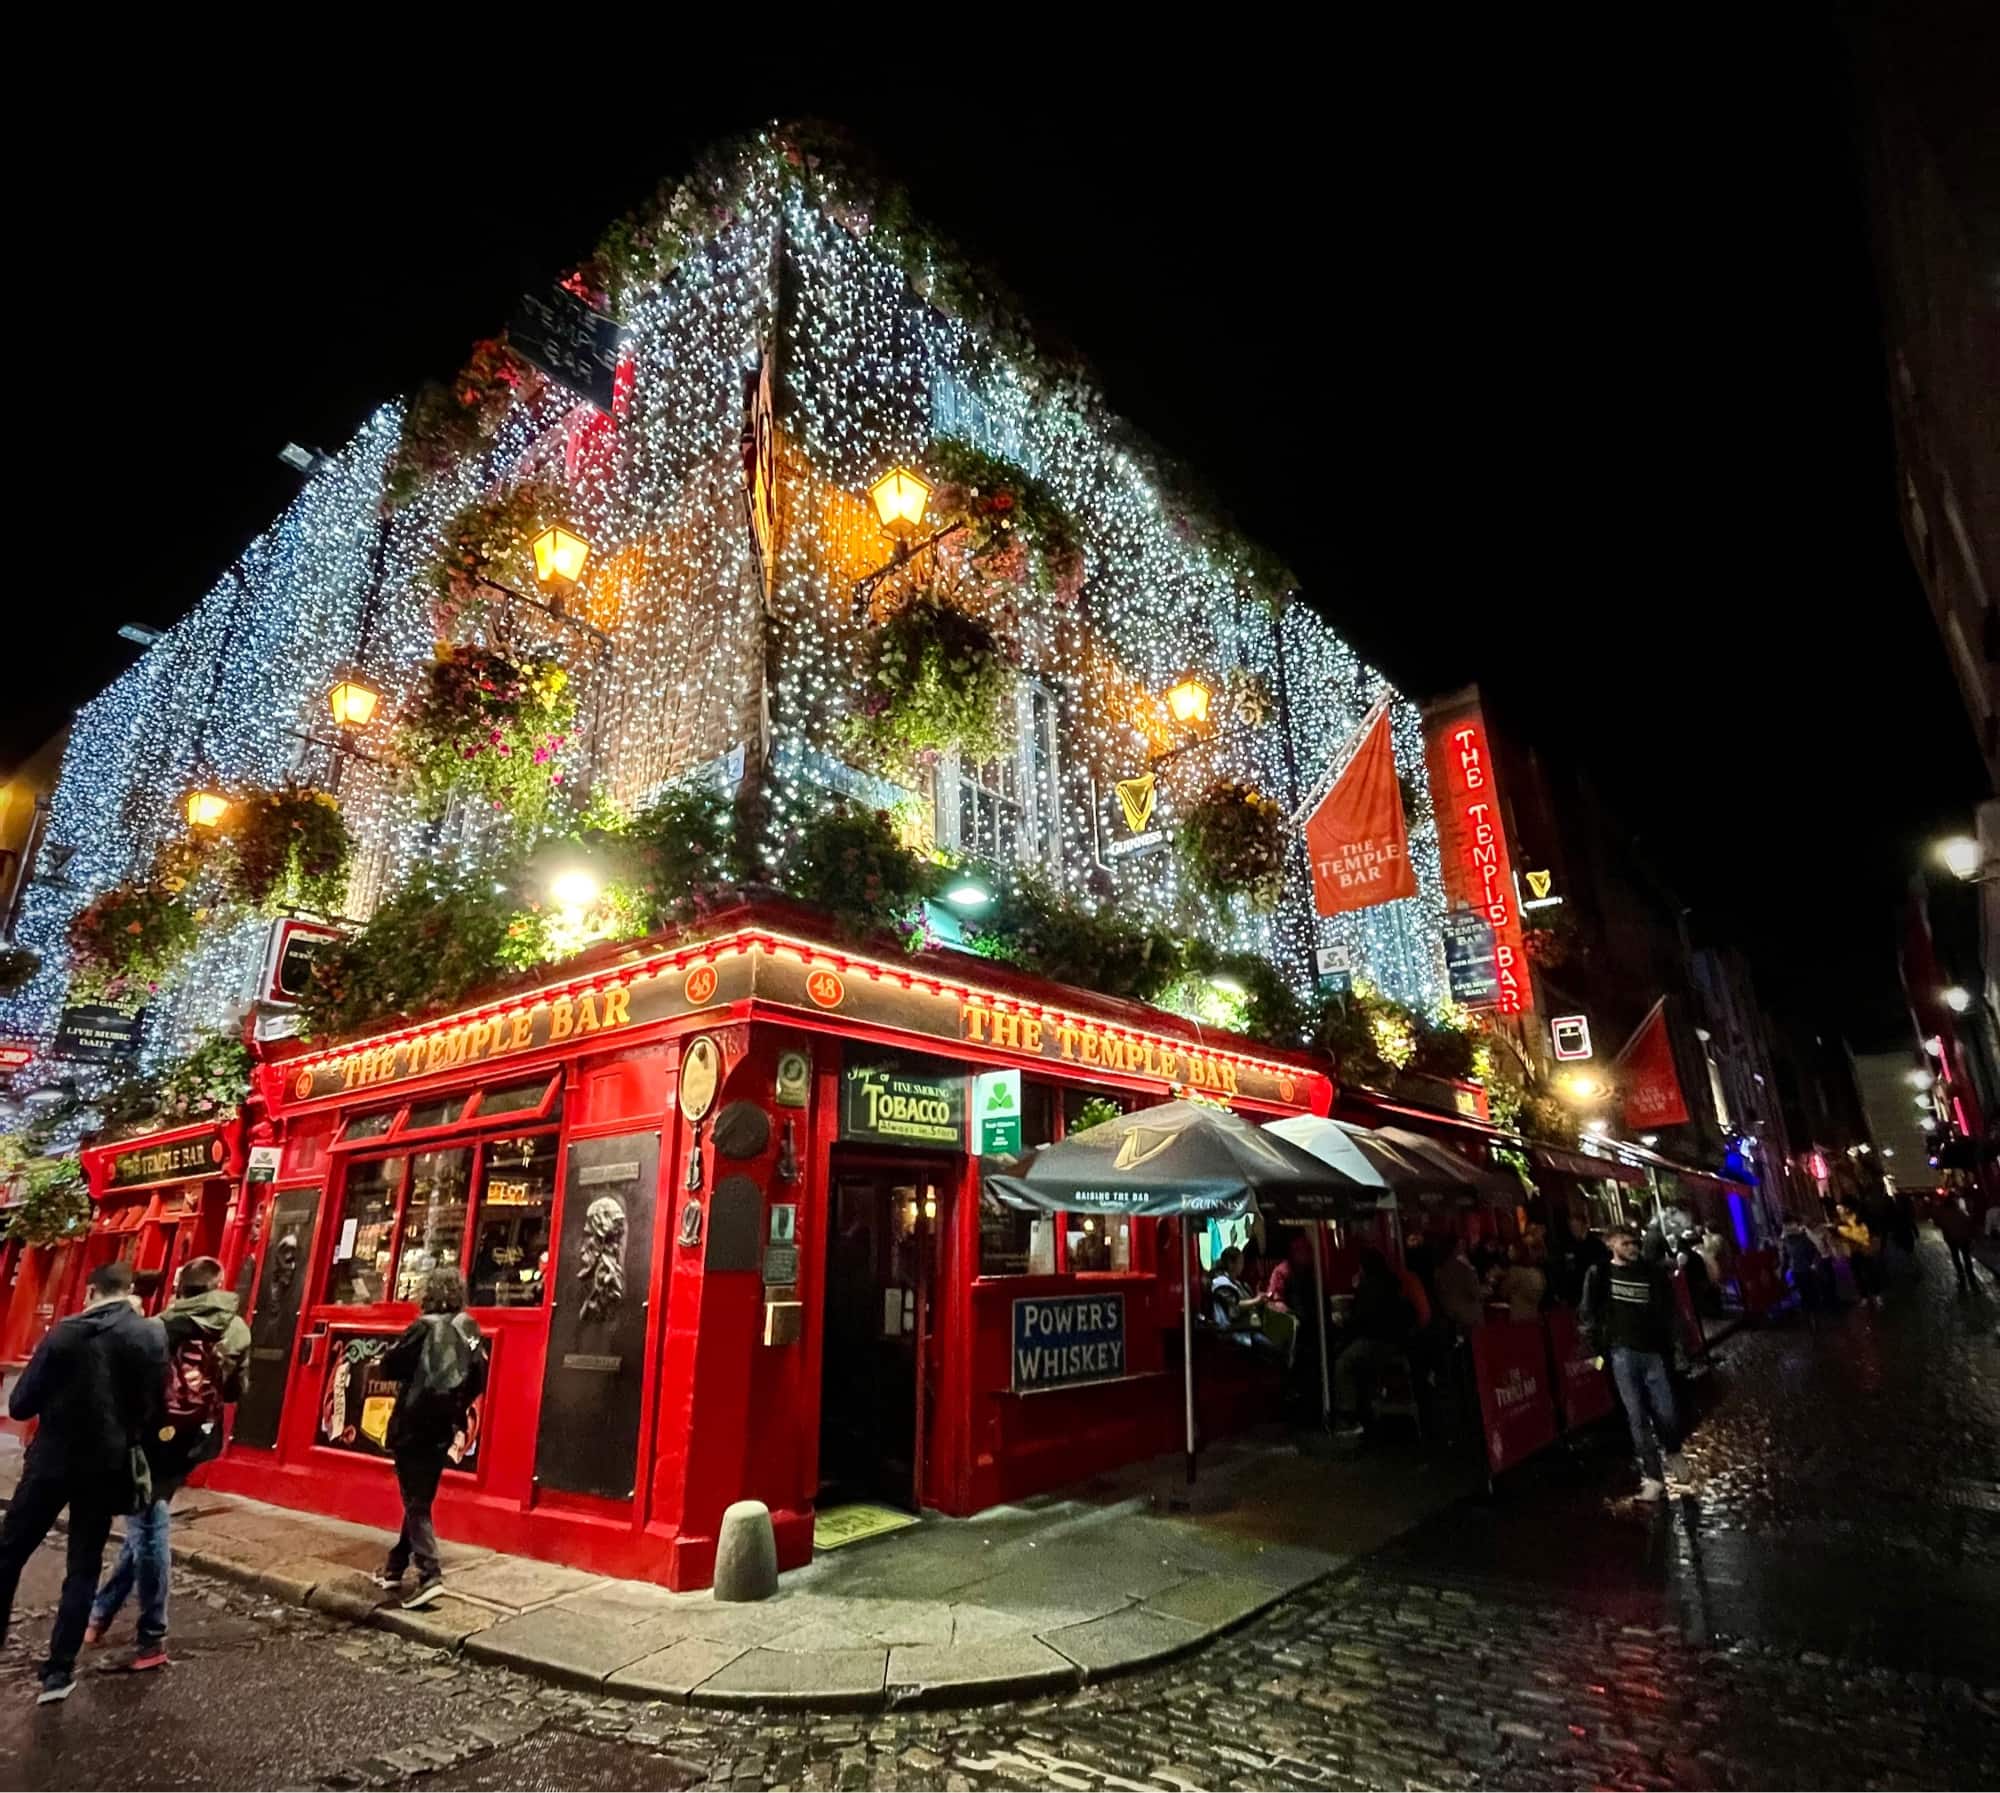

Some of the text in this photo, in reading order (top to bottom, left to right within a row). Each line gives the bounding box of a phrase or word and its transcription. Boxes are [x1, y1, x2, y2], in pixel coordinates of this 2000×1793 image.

[1455, 729, 1485, 789] THE
[1110, 830, 1163, 855] GUINNESS
[1340, 840, 1374, 857] THE
[1317, 844, 1401, 878] TEMPLE
[1468, 804, 1508, 927] TEMPLE
[1339, 866, 1382, 888] BAR
[690, 973, 712, 997] 48
[813, 976, 836, 999] 48
[1496, 946, 1521, 1013] BAR
[66, 1026, 131, 1041] LIVE MUSIC
[79, 1038, 114, 1049] DAILY
[343, 986, 631, 1088] THE TEMPLE BAR
[963, 1004, 1044, 1054] THE
[1056, 1028, 1179, 1080] TEMPLE
[1188, 1058, 1239, 1095] BAR
[893, 1081, 950, 1099] FINE SMOKING
[861, 1083, 950, 1127] TOBACCO
[142, 1149, 180, 1175] TEMPLE
[181, 1144, 206, 1168] BAR
[1075, 1190, 1149, 1201] RAISING THE BAR
[1190, 1196, 1245, 1210] GUINNESS
[1024, 1302, 1118, 1338] POWER'S
[1017, 1341, 1122, 1382] WHISKEY
